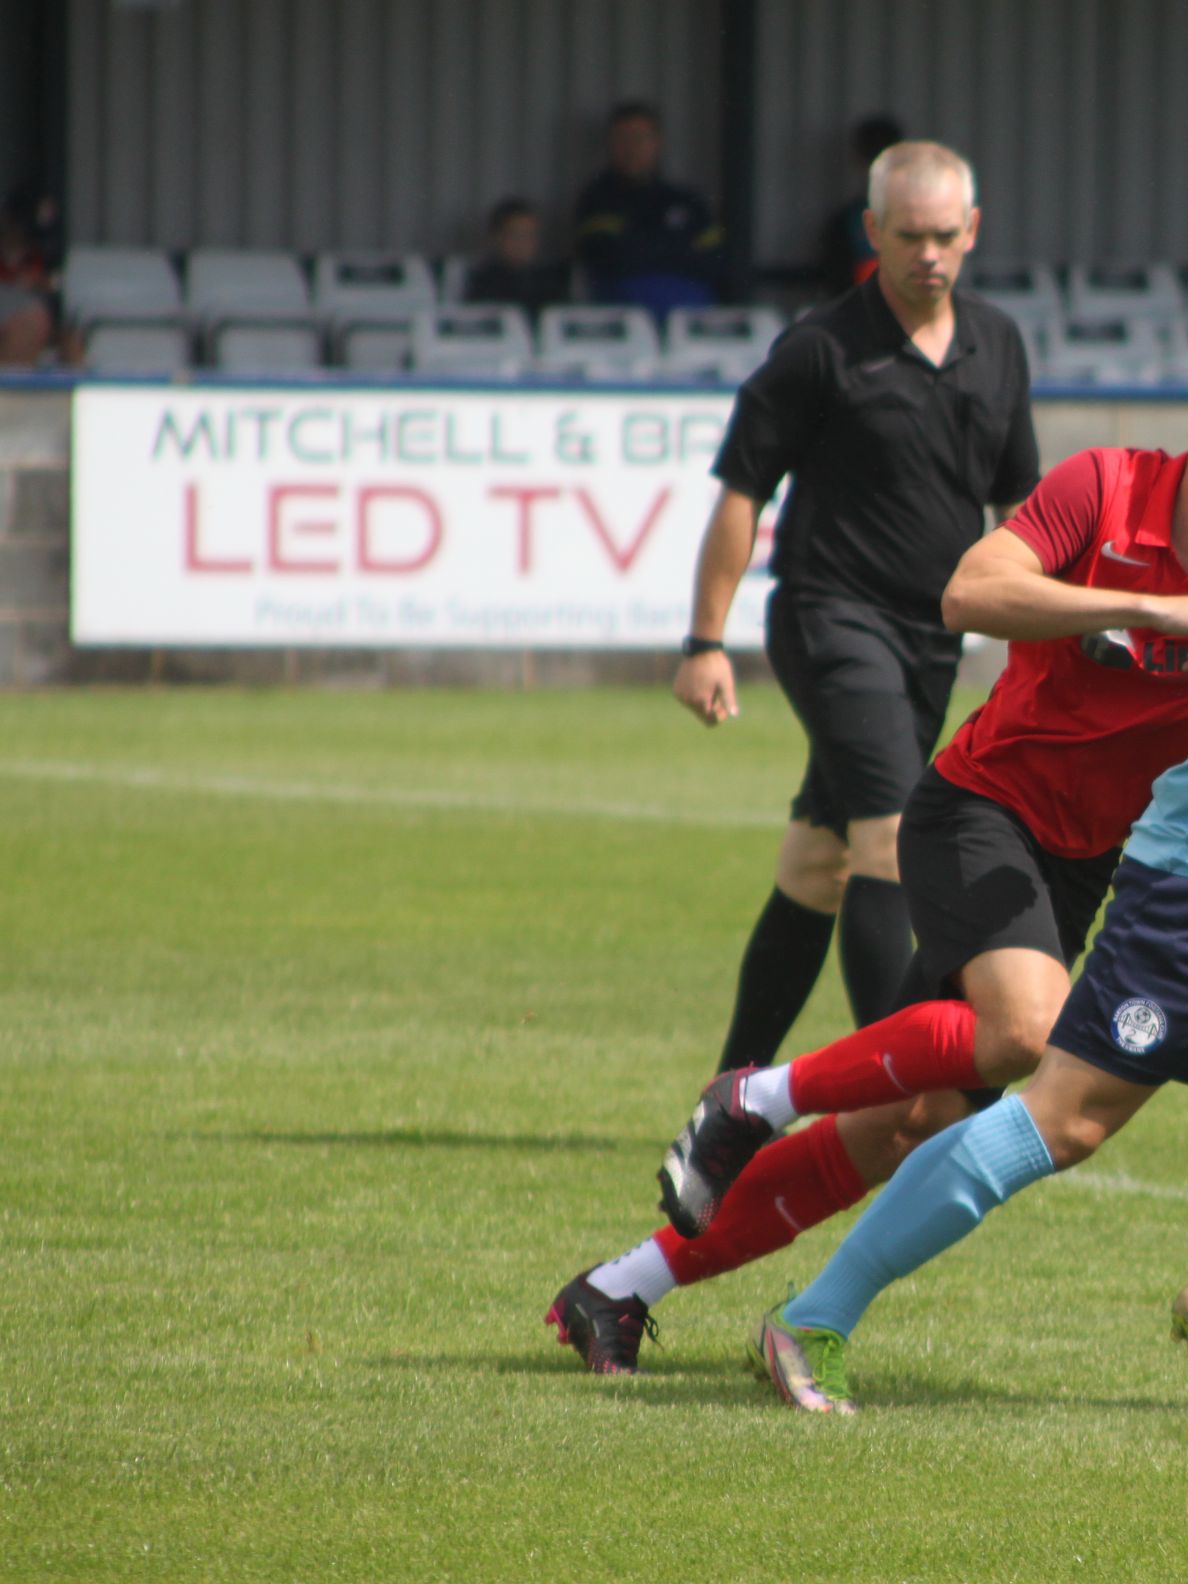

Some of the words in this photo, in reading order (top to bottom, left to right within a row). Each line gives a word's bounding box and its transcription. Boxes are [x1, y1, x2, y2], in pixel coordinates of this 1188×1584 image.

[152, 407, 531, 466] MITCHELL
[554, 413, 595, 467] &
[621, 411, 728, 468] BR
[183, 484, 445, 576] LED
[487, 484, 672, 576] TV
